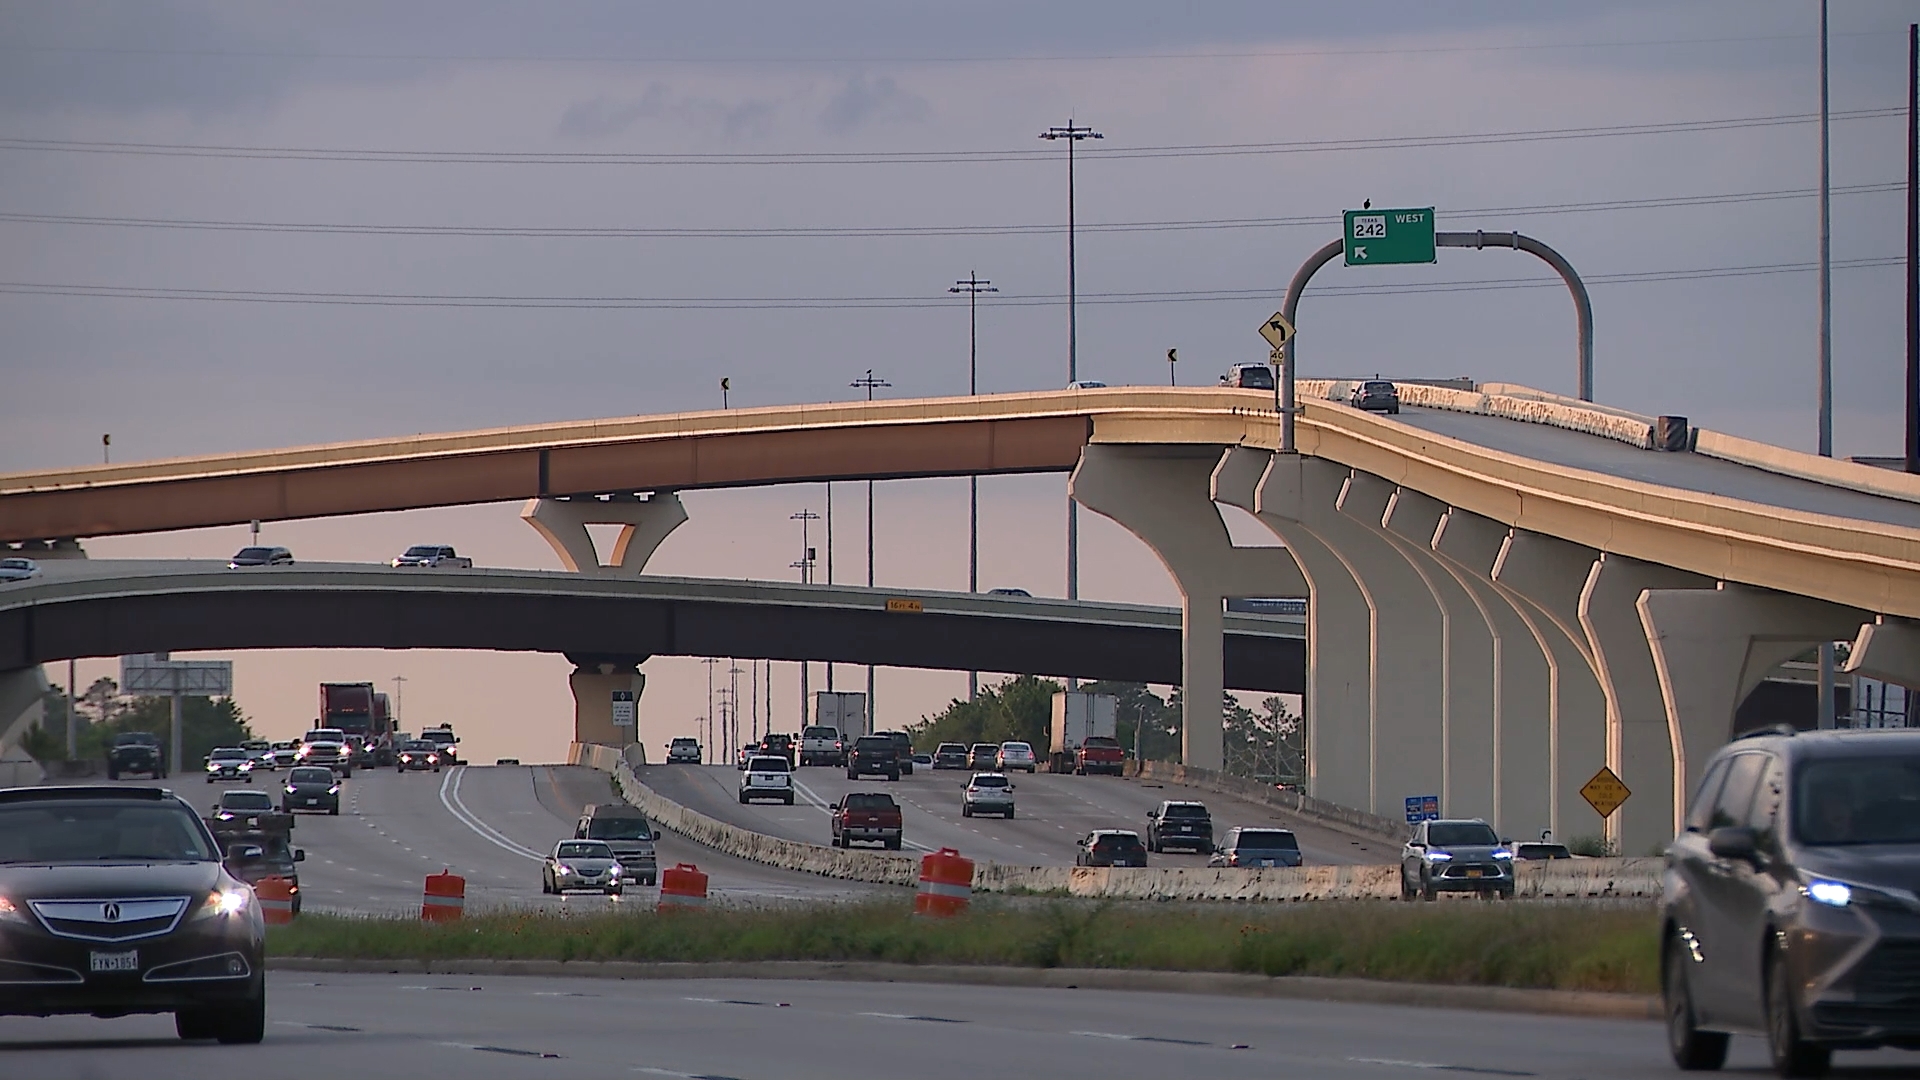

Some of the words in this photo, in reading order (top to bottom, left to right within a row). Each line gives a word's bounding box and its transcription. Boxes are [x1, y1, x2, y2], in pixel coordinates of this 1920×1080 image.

[1395, 214, 1425, 224] WEST
[1355, 224, 1384, 237] 242
[1270, 352, 1284, 360] 40
